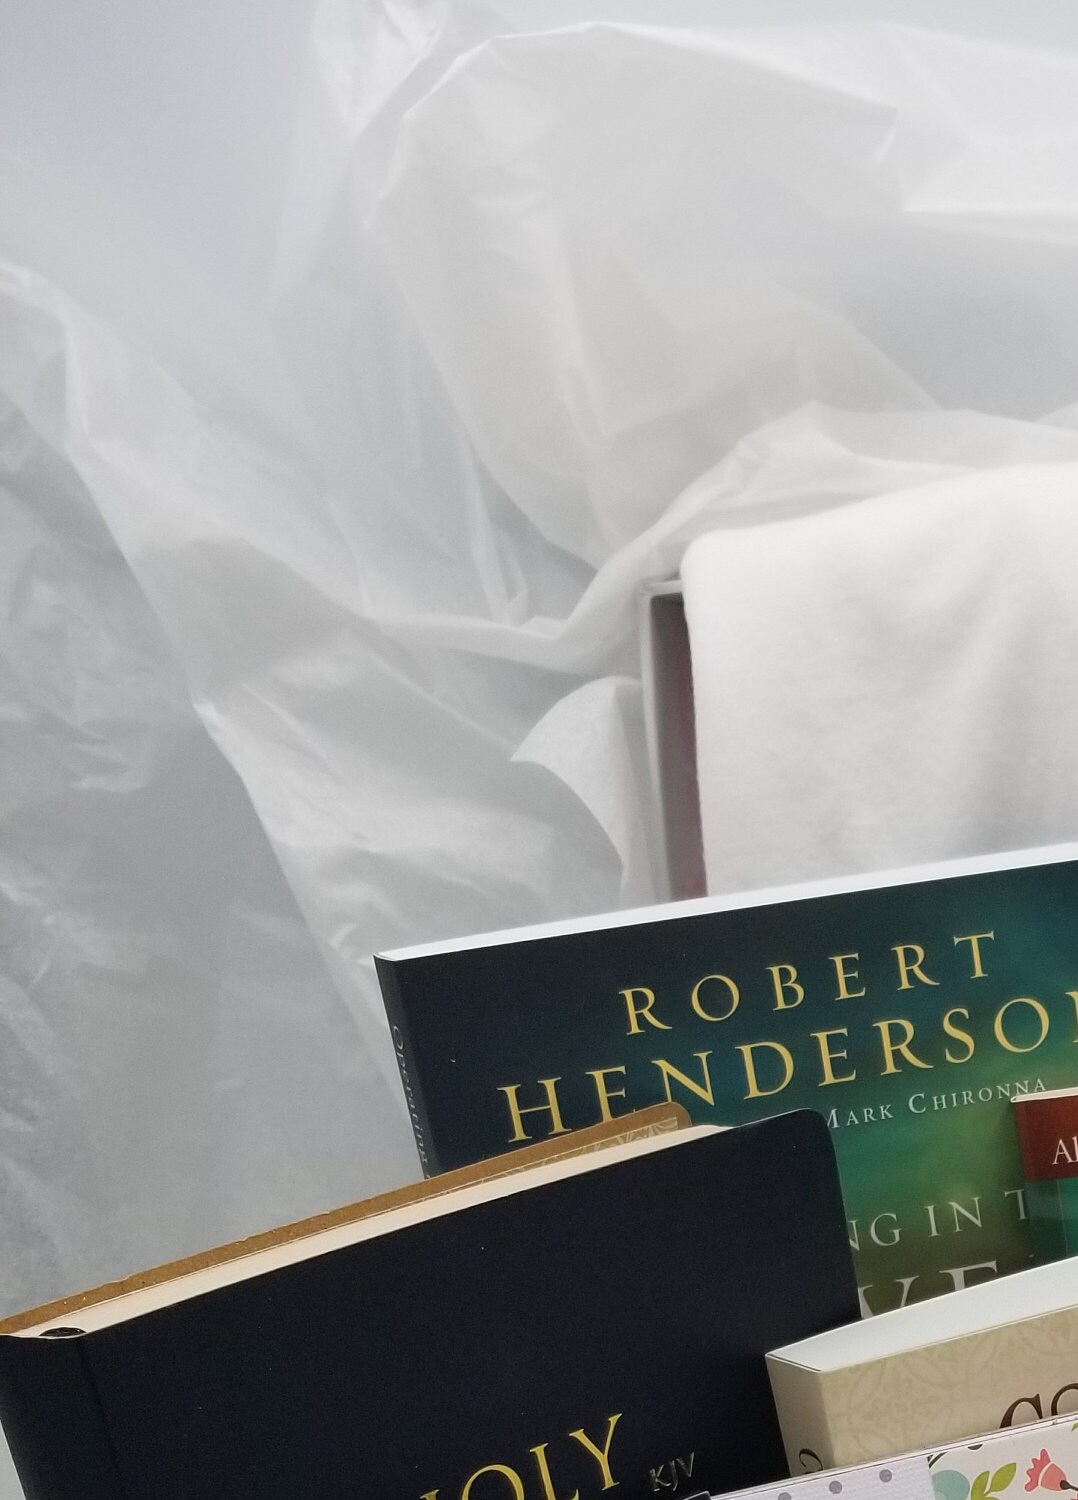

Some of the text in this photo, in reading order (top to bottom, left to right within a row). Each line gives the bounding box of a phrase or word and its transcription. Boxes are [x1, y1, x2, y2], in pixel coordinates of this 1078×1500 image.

[621, 930, 996, 1036] ROBERT
[924, 1196, 983, 1238] IN
[649, 1451, 695, 1491] KJV
